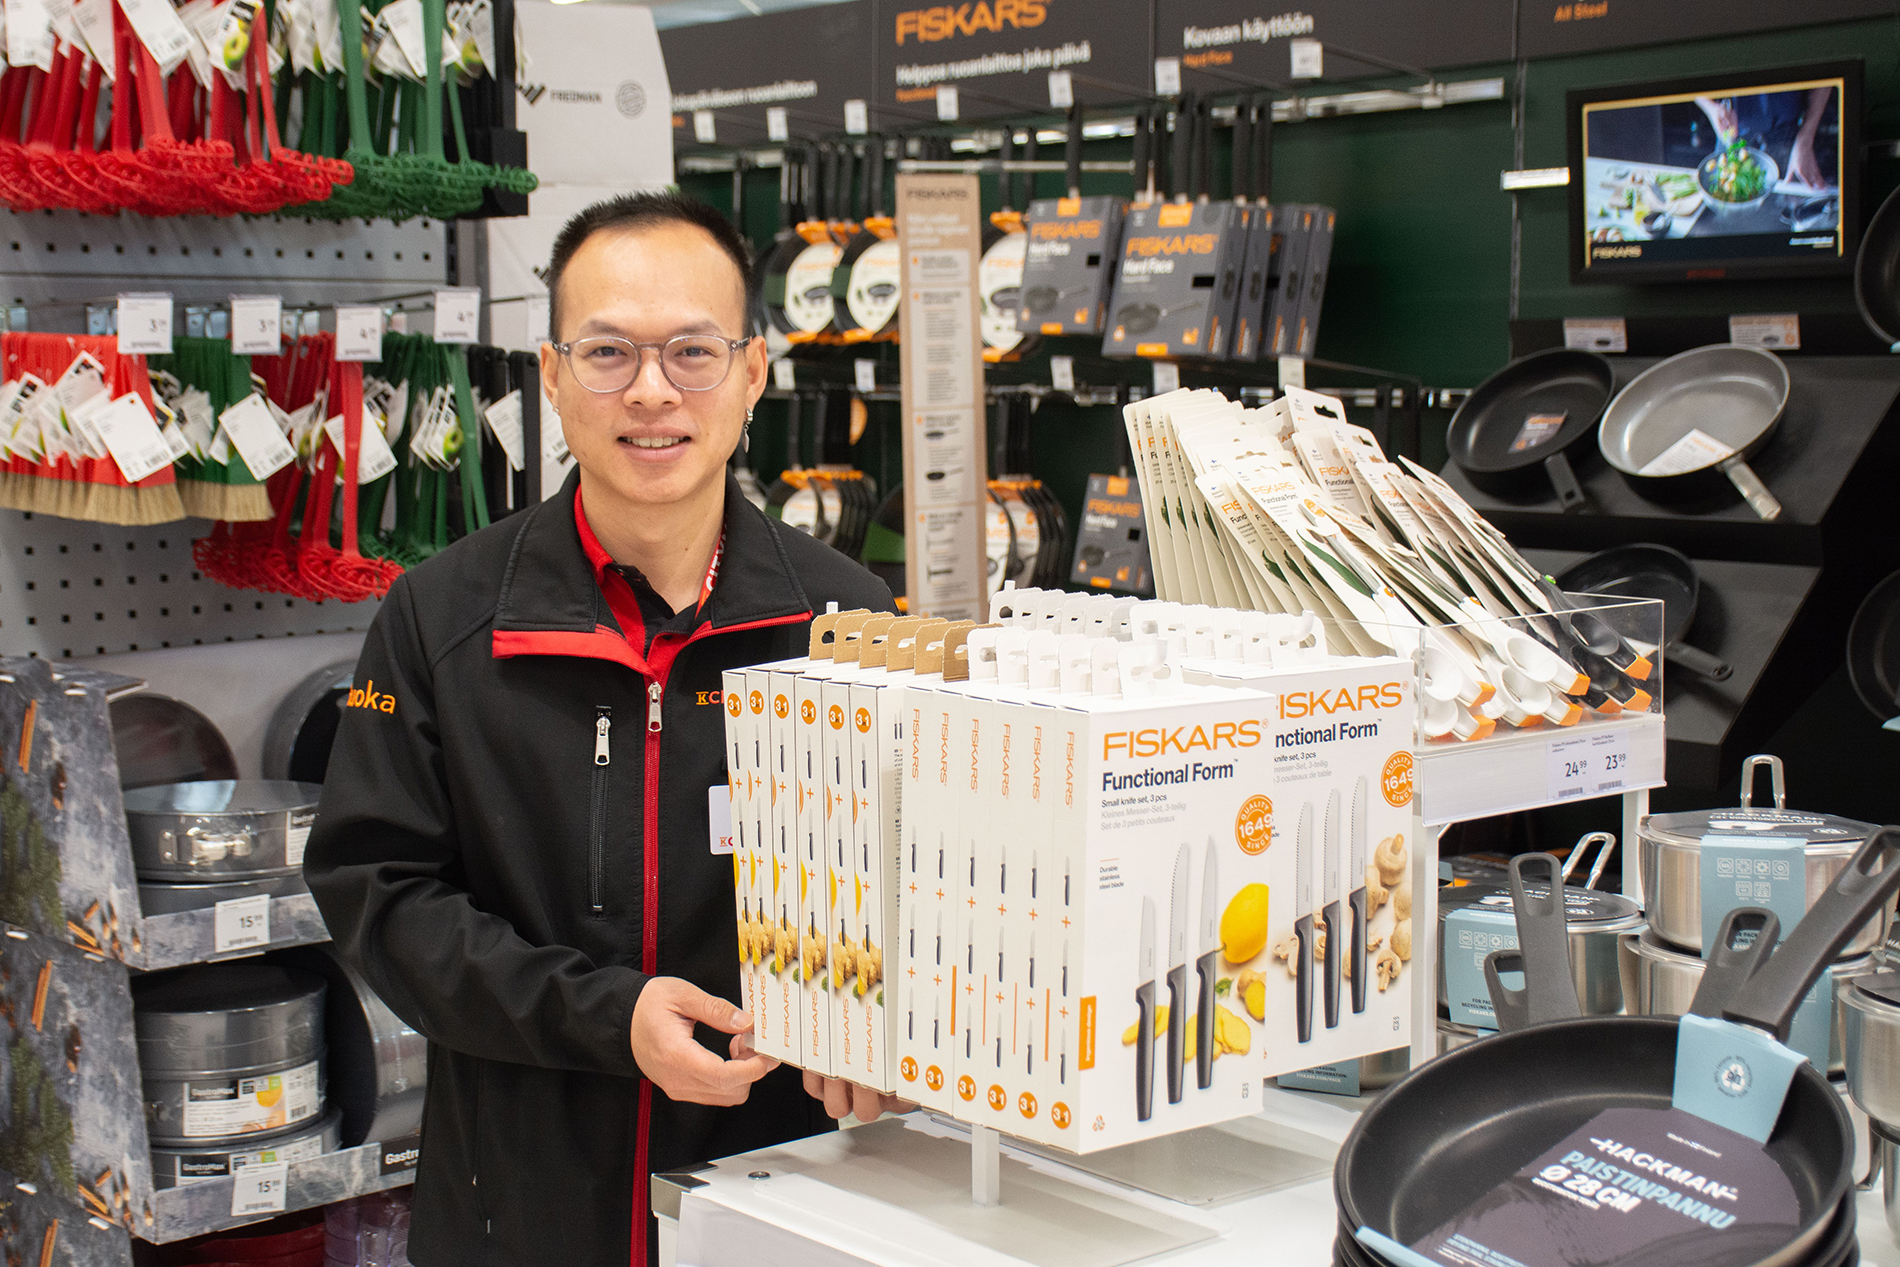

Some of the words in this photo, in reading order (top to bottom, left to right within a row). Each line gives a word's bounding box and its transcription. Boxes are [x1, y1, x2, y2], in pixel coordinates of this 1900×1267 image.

[896, 0, 1047, 46] FISKARS
[1184, 24, 1241, 49] Kovaan
[1242, 11, 1314, 43] käyttöön
[1022, 47, 1052, 74] joka
[1053, 40, 1092, 70] päivä
[551, 89, 602, 103] FREDMAN
[1030, 220, 1102, 241] FISKARS
[1126, 234, 1215, 257] FISKARS
[1592, 245, 1642, 259] FISKARS
[1251, 481, 1296, 496] FISKARS
[1276, 682, 1402, 719] ISKARS
[1103, 719, 1261, 761] FISKARS
[1340, 721, 1378, 740] Form
[912, 708, 920, 779] FISKARS
[939, 712, 949, 784] FISKARS
[970, 718, 979, 790] FISKARS
[1001, 723, 1010, 797] FISKARS
[1032, 725, 1041, 800] FISKARS
[1305, 751, 1317, 760] pcs
[1605, 754, 1618, 770] 23
[1065, 731, 1074, 806] FISKARS
[1102, 763, 1189, 792] Functional
[1192, 760, 1235, 782] Form
[1309, 771, 1317, 779] de
[1317, 770, 1332, 778] table
[1386, 757, 1412, 776] QUALITY
[1565, 761, 1579, 777] 24
[1101, 799, 1120, 808] Small
[1120, 796, 1137, 806] knife
[1137, 795, 1150, 804] set,
[1155, 794, 1168, 804] pcs
[1101, 810, 1125, 819] Kleines
[1126, 804, 1164, 816] Messer-Set,
[1164, 802, 1187, 812] 3-teilig
[1241, 801, 1269, 821] QUALITY
[1101, 821, 1112, 831] Set
[1112, 821, 1122, 829] de
[1122, 820, 1127, 828] 3
[1127, 818, 1146, 829] petits
[1146, 815, 1175, 826] couteaux
[1239, 813, 1273, 839] 1649
[1099, 865, 1118, 874] Durable
[1099, 874, 1120, 882] stainless
[1111, 881, 1125, 889] blade
[240, 915, 254, 929] 15
[1461, 1002, 1487, 1010] RECYCLING
[843, 997, 851, 1065] FISKARS
[1591, 1138, 1735, 1200] HACKMAN
[257, 1180, 271, 1194] 15
[1560, 1150, 1737, 1229] PAISTINPANNU
[1563, 1174, 1602, 1196] 28
[1595, 1186, 1641, 1213] CM
